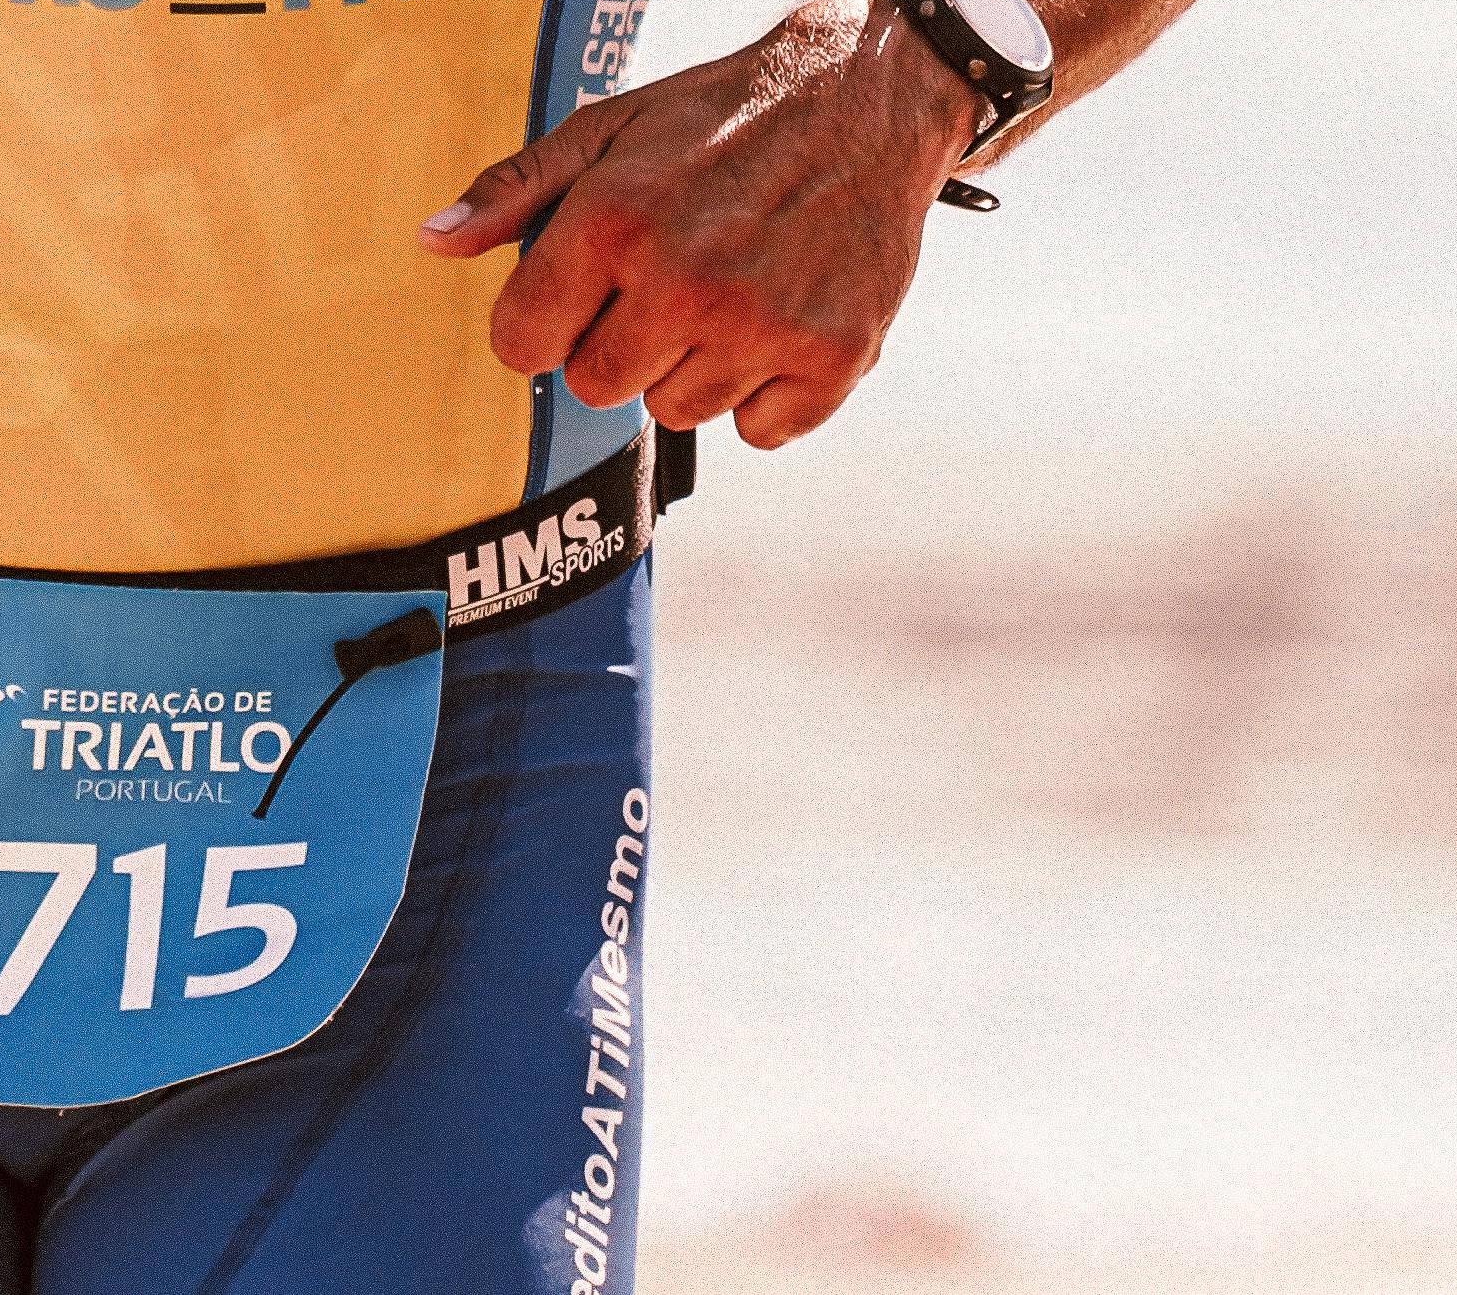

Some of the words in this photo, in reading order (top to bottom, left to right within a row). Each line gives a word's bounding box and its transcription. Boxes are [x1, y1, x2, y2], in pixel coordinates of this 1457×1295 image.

[447, 498, 601, 609] HMS
[550, 525, 625, 587] SPORTS
[42, 688, 224, 718] FEDERAÇÃO
[234, 691, 272, 713] DE
[20, 718, 292, 773] TRIATLO
[75, 778, 231, 804] PORTUGAL
